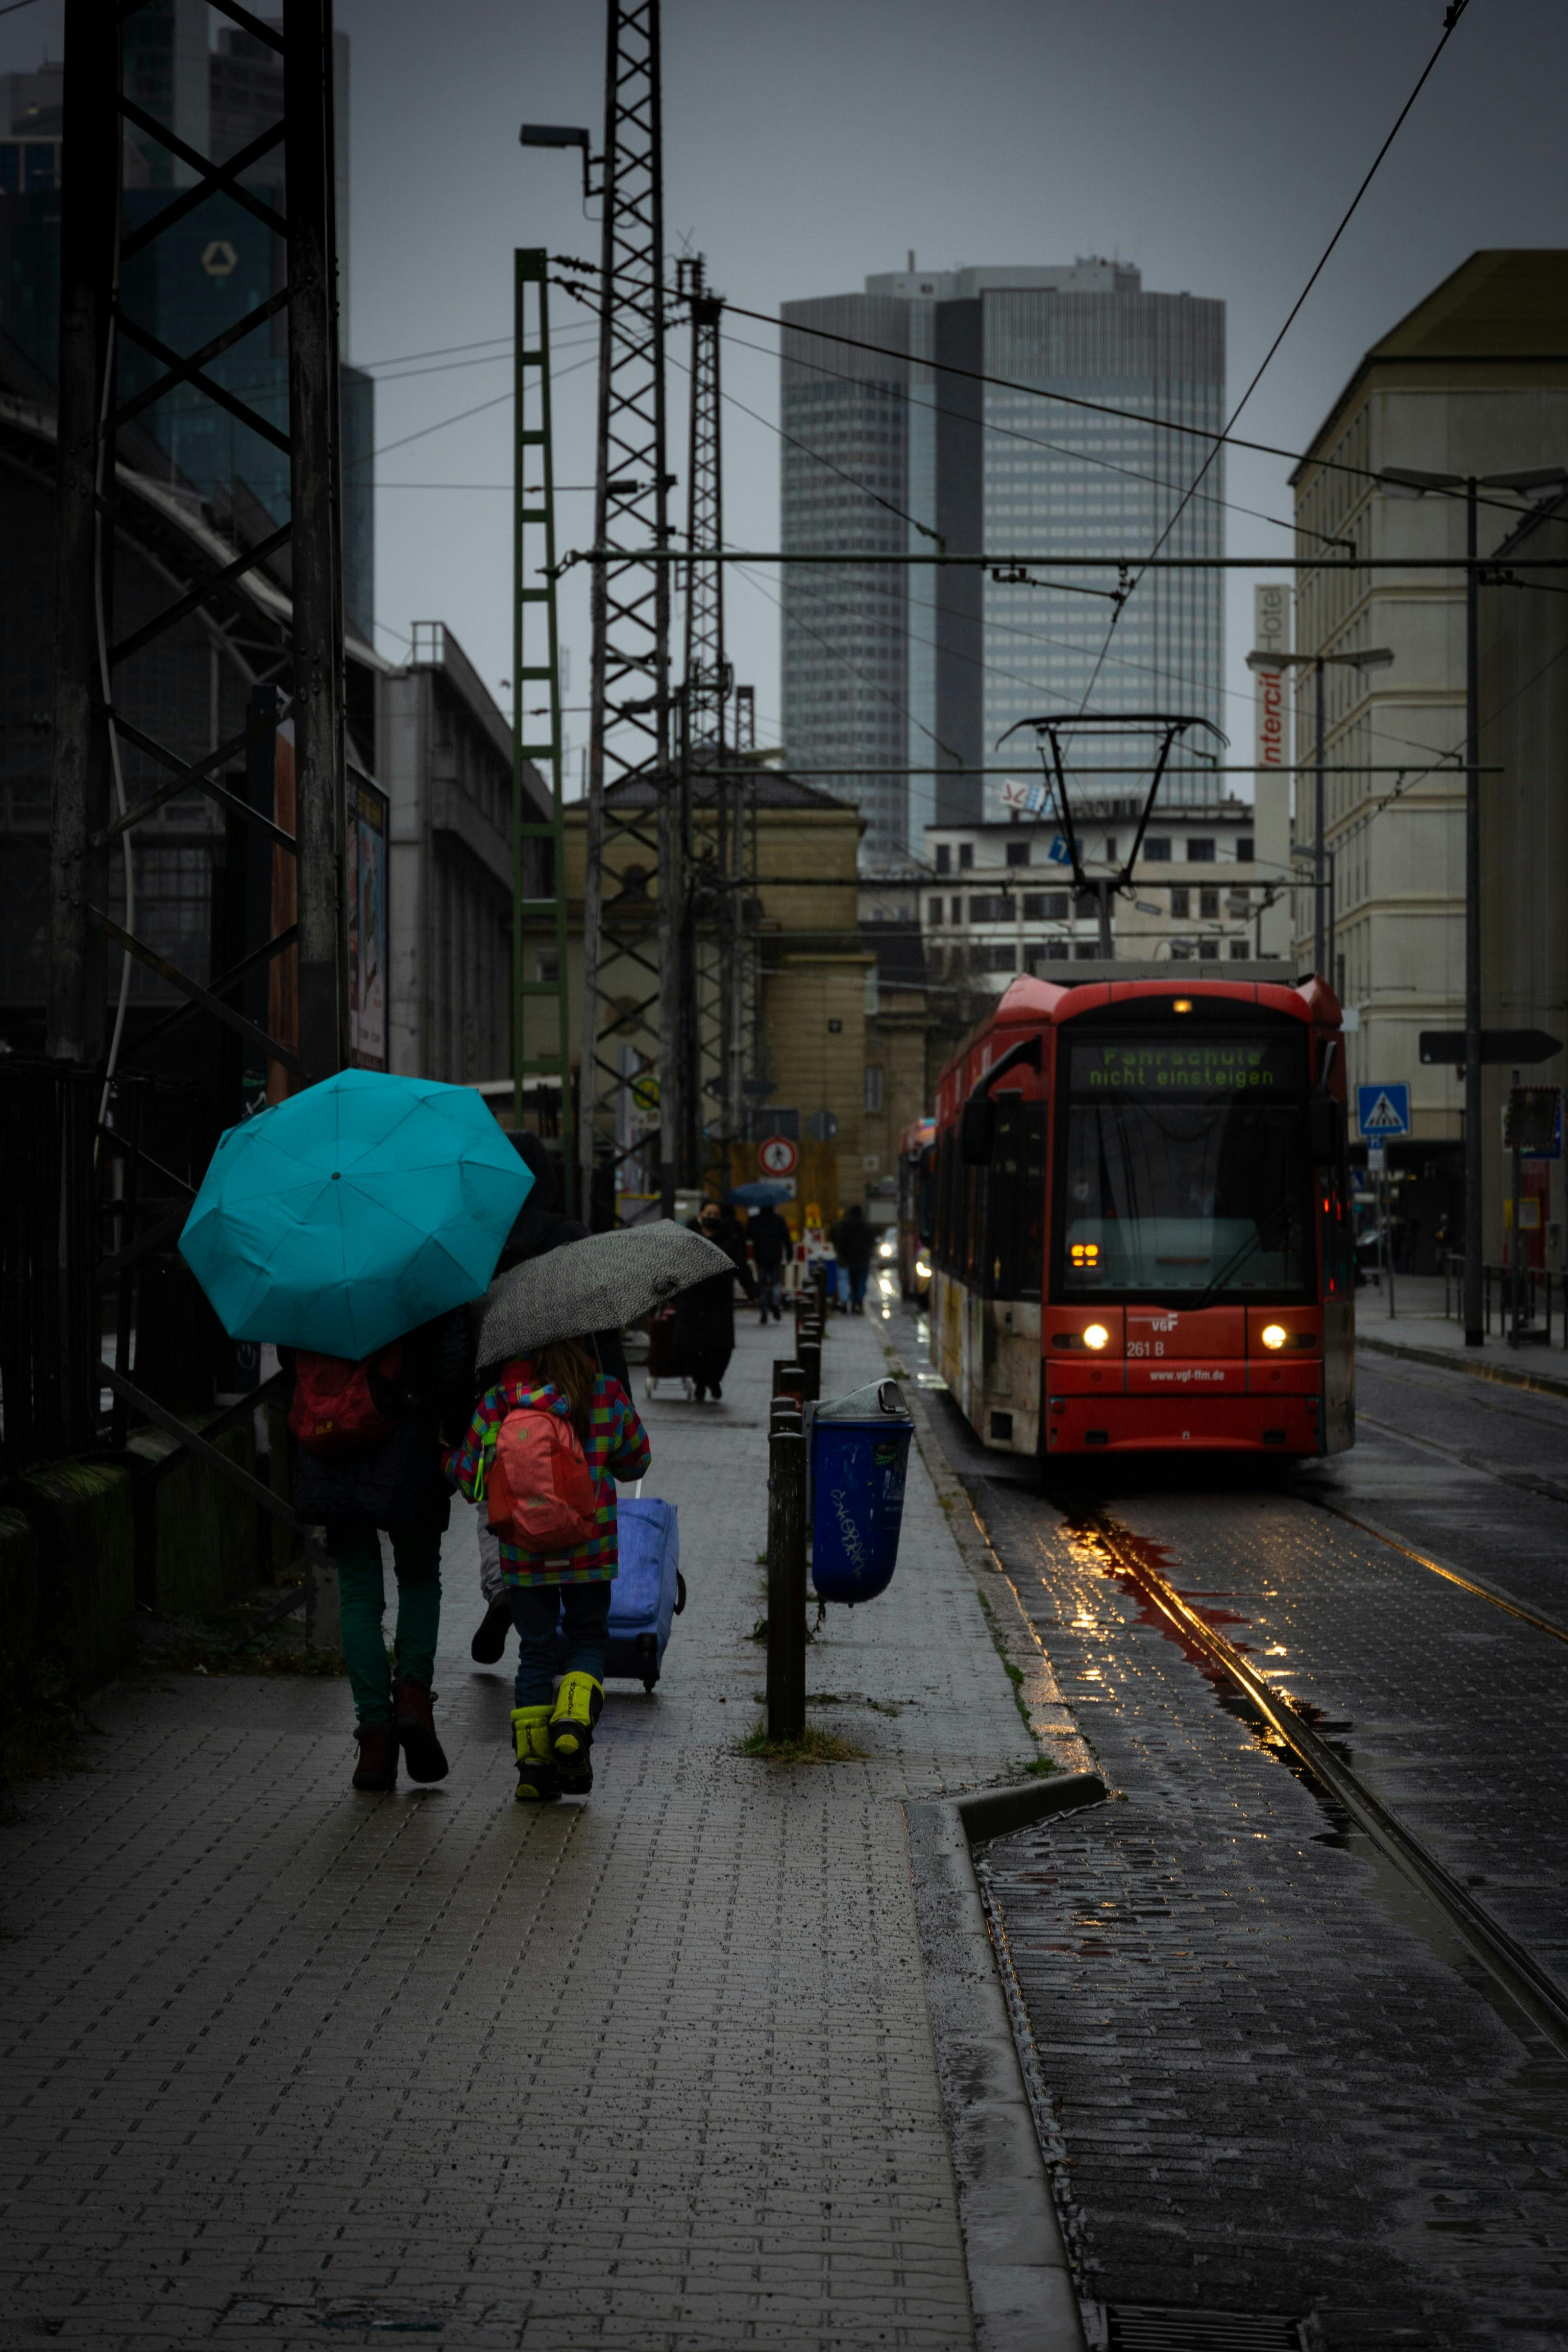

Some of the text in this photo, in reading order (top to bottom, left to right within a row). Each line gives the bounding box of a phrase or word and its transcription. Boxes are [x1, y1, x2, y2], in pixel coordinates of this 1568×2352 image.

[1104, 1047, 1262, 1066] Fahrschule
[1090, 1068, 1275, 1089] nicht einsteigen
[1126, 1340, 1165, 1357] 261 B
[1149, 1369, 1225, 1383] www.vgf-ffm.de
